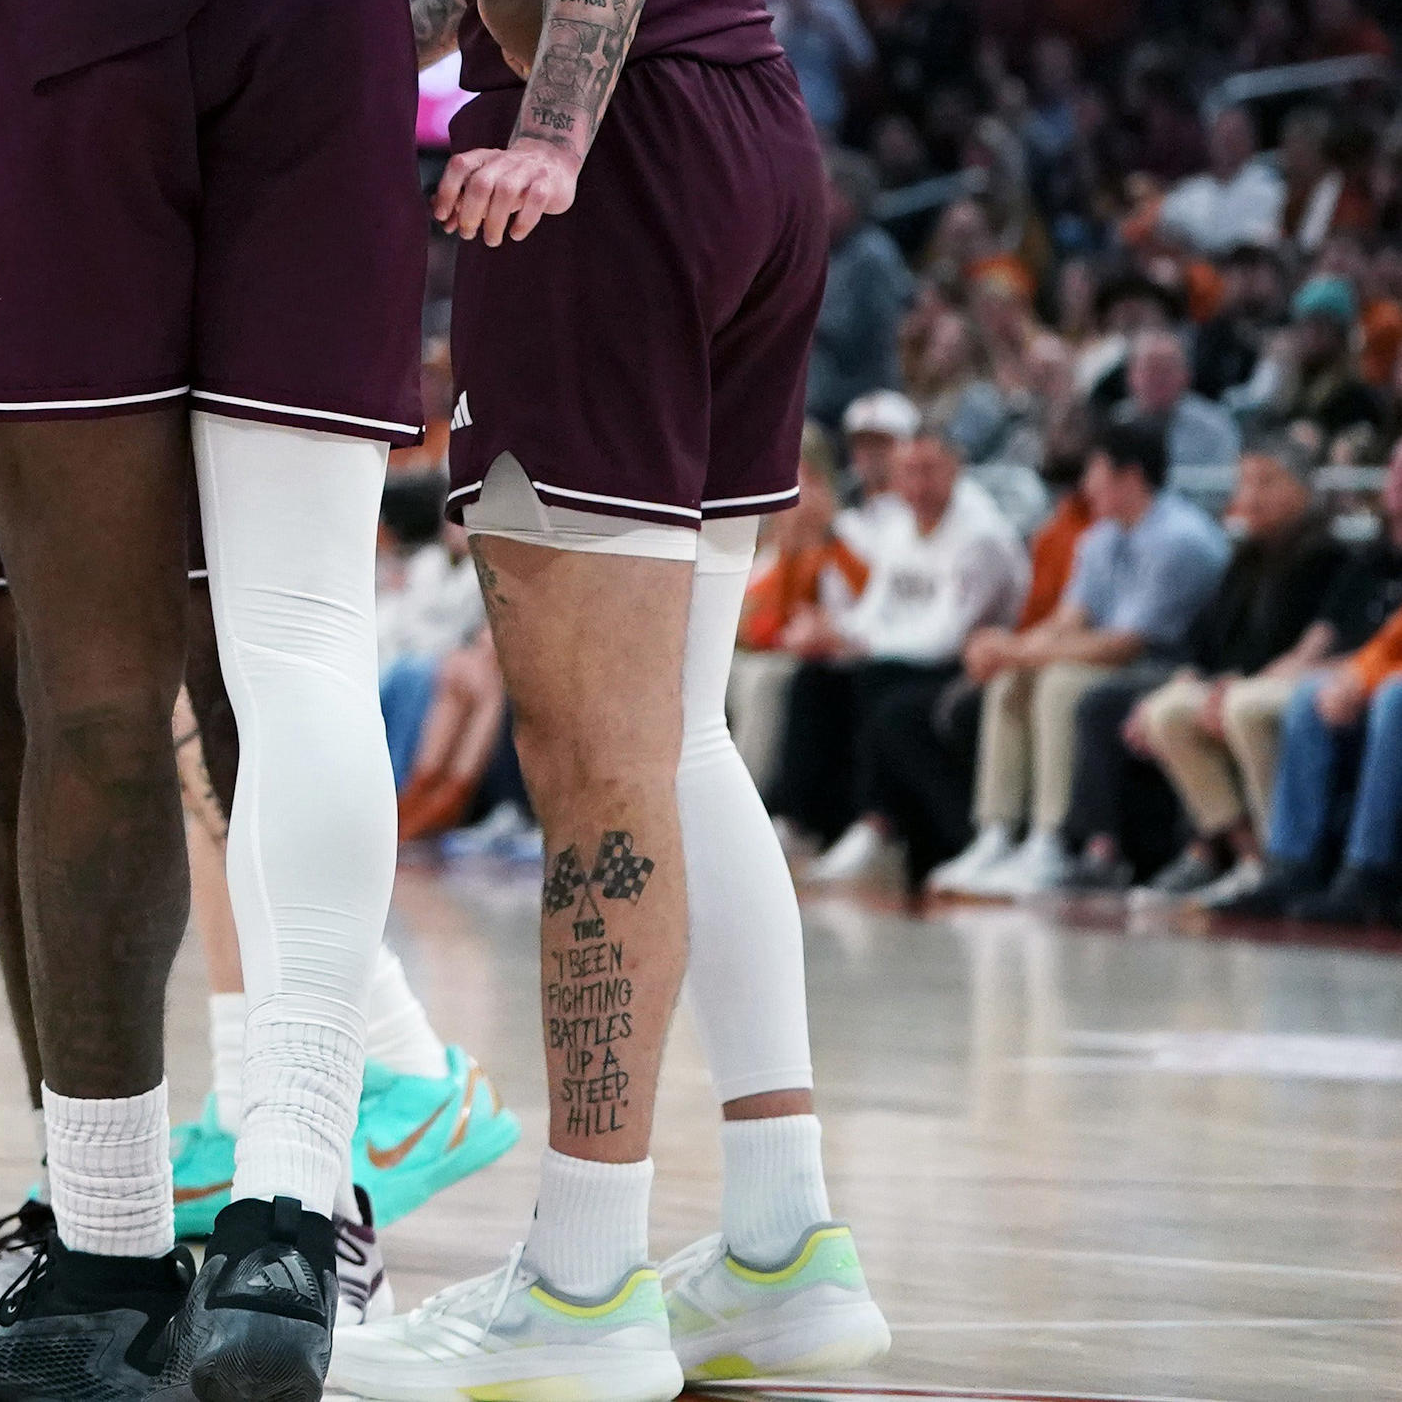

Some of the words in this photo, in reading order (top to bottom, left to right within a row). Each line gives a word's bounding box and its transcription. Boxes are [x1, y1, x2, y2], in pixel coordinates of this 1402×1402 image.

[568, 941, 622, 978] BEEN
[548, 978, 632, 1014] FIGHTING
[550, 1012, 633, 1049] BATTLES
[567, 1047, 594, 1078] UP
[603, 1046, 620, 1076] A
[562, 1071, 629, 1105] STEEP
